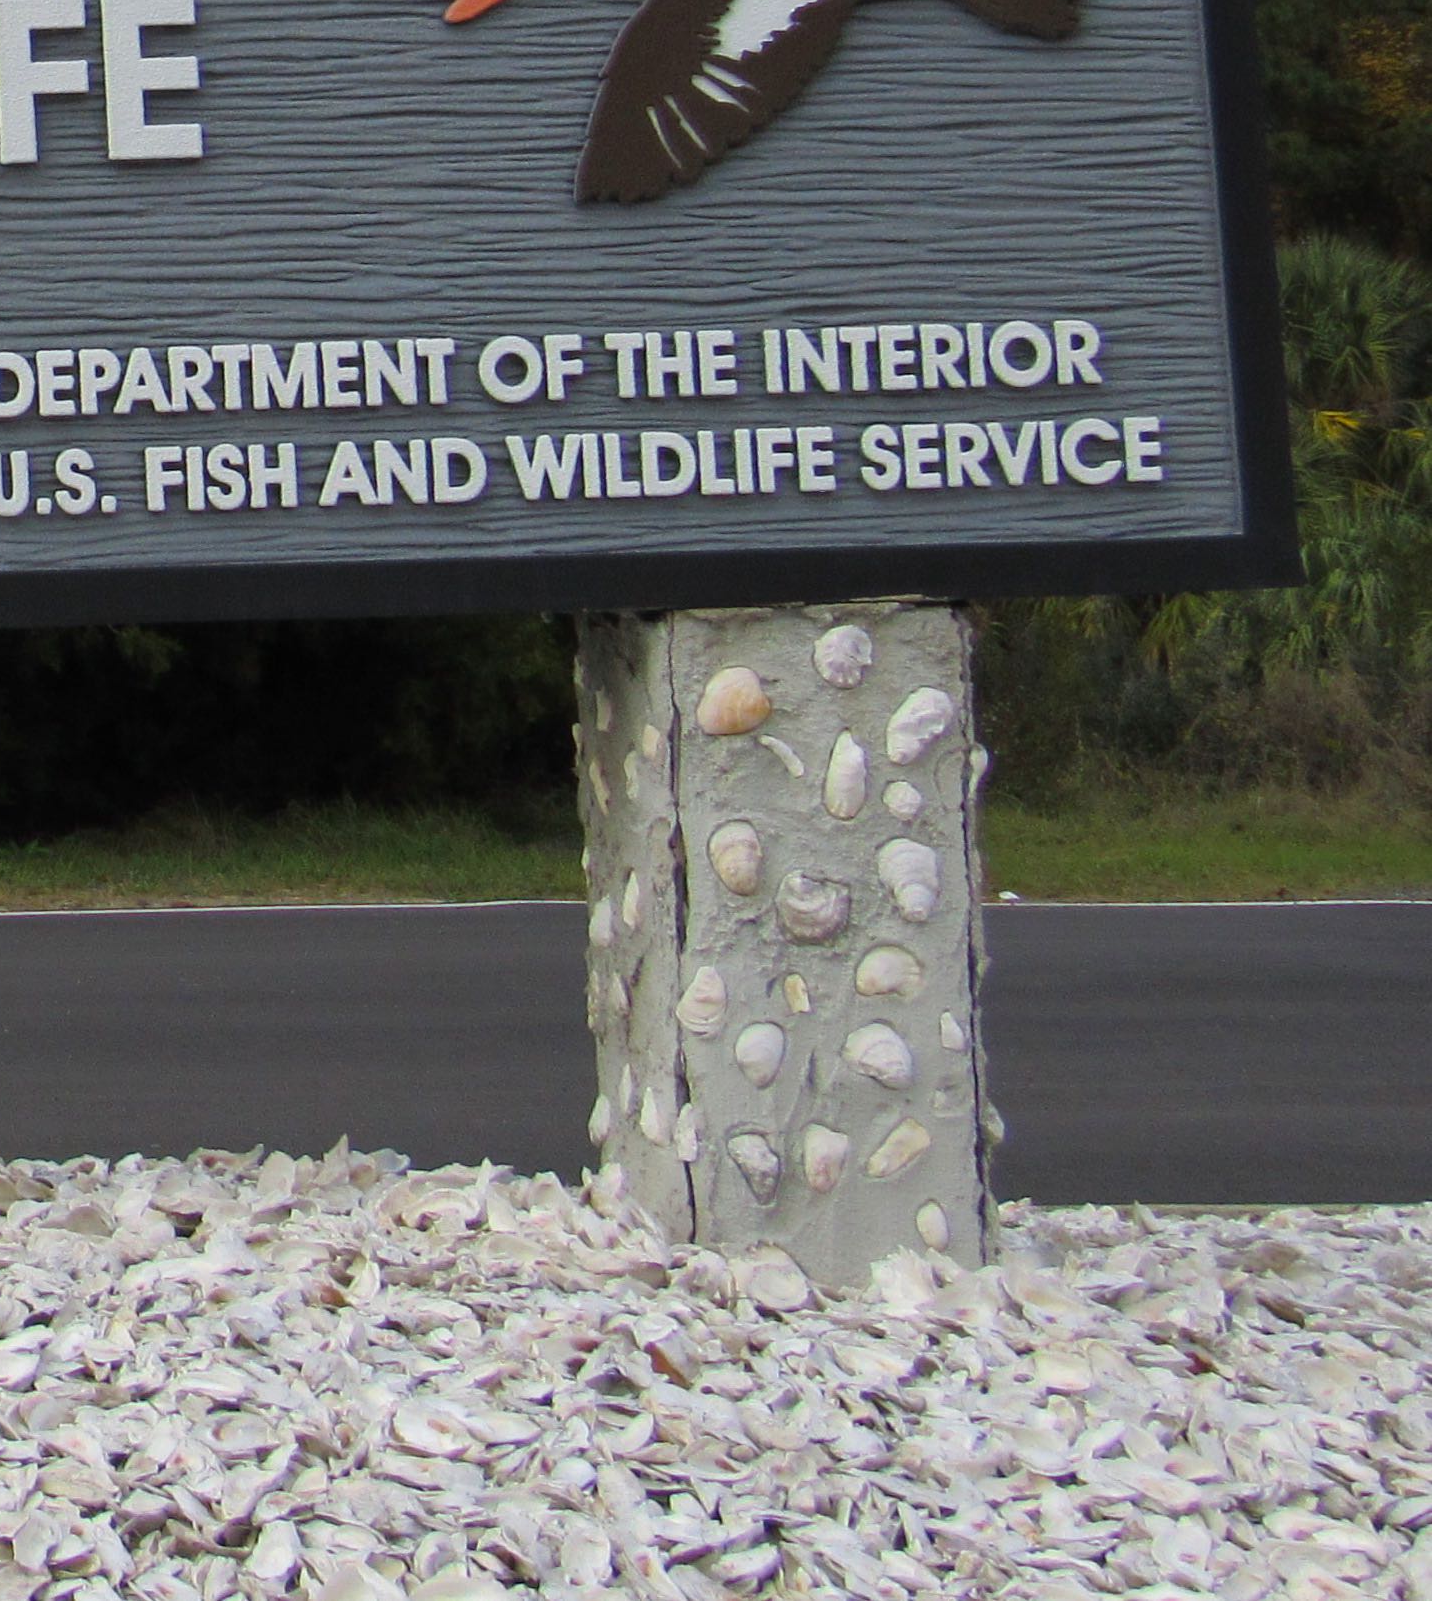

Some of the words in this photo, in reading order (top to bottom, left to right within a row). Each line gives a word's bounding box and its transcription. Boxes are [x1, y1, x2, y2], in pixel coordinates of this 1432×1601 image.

[478, 334, 583, 403] OF
[604, 329, 738, 397] THE
[763, 320, 1102, 392] INTERIOR
[145, 442, 298, 511] FISH
[319, 437, 487, 506] AND
[505, 426, 836, 499] WILDLIFE
[861, 416, 1163, 490] SERVICE
